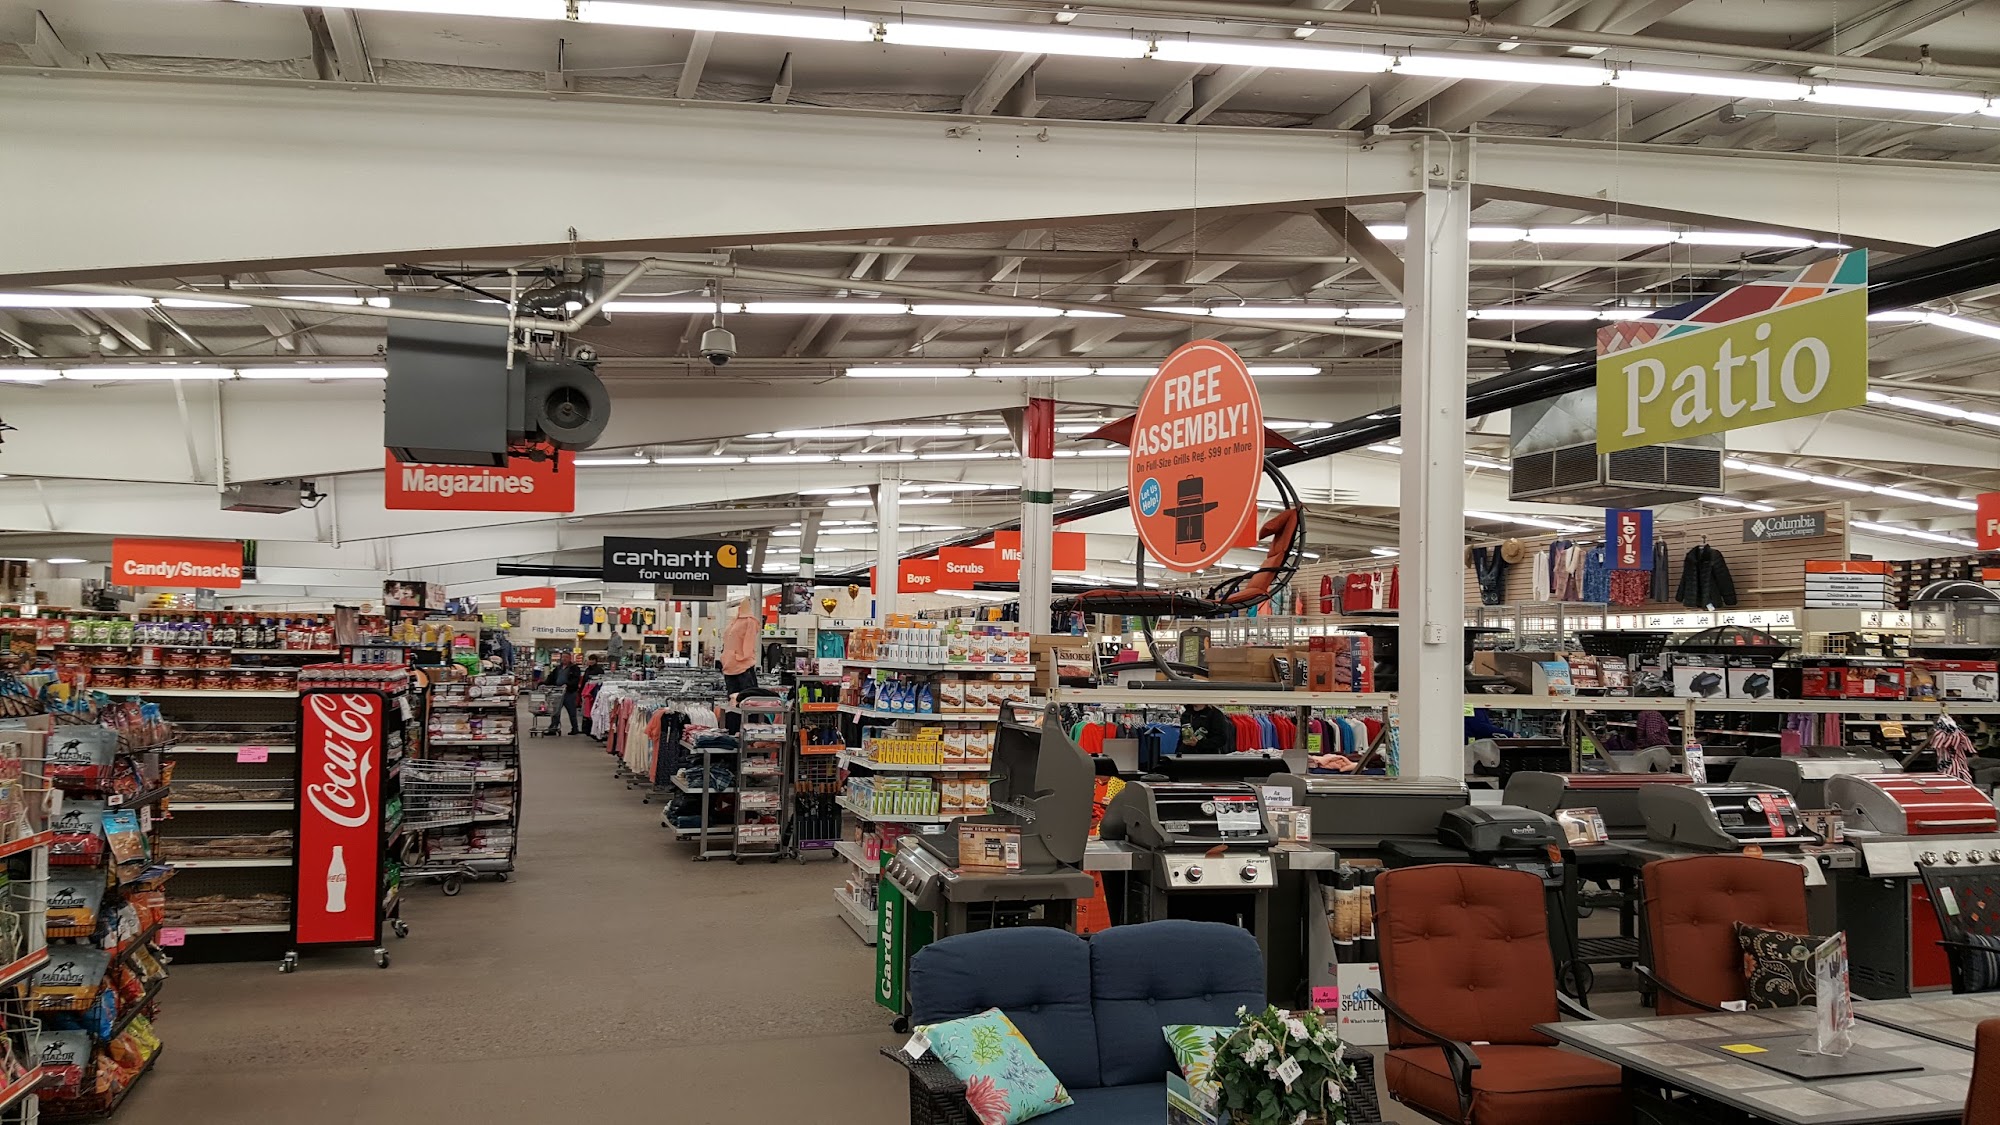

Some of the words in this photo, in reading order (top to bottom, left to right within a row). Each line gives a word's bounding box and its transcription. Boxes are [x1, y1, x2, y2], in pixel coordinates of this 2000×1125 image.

[1621, 322, 1831, 437] Patio
[1164, 365, 1221, 415] FREE
[1136, 402, 1249, 458] ASSEMBLY!
[1136, 463, 1145, 473] On
[1146, 457, 1172, 472] Full-Size
[1173, 453, 1190, 466] Grills
[1192, 451, 1207, 463] Reg.
[1208, 446, 1222, 459] $99
[1224, 447, 1231, 456] or
[1233, 442, 1253, 454] More
[402, 468, 535, 497] Magazines
[1140, 489, 1150, 500] Let
[1149, 484, 1158, 494] Us
[1142, 493, 1159, 512] Help!
[1766, 514, 1816, 531] Columbia
[612, 549, 714, 568] carhartt
[1840, 562, 1847, 573] 1
[123, 559, 241, 579] Candy/Snacks
[638, 568, 661, 580] for
[663, 570, 710, 581] women
[946, 562, 985, 574] Scrubs
[906, 573, 931, 585] Boys
[504, 596, 543, 604] Workwear
[1776, 613, 1790, 623] Lee
[1059, 652, 1091, 662] SMOKE
[881, 900, 893, 1000] Garden
